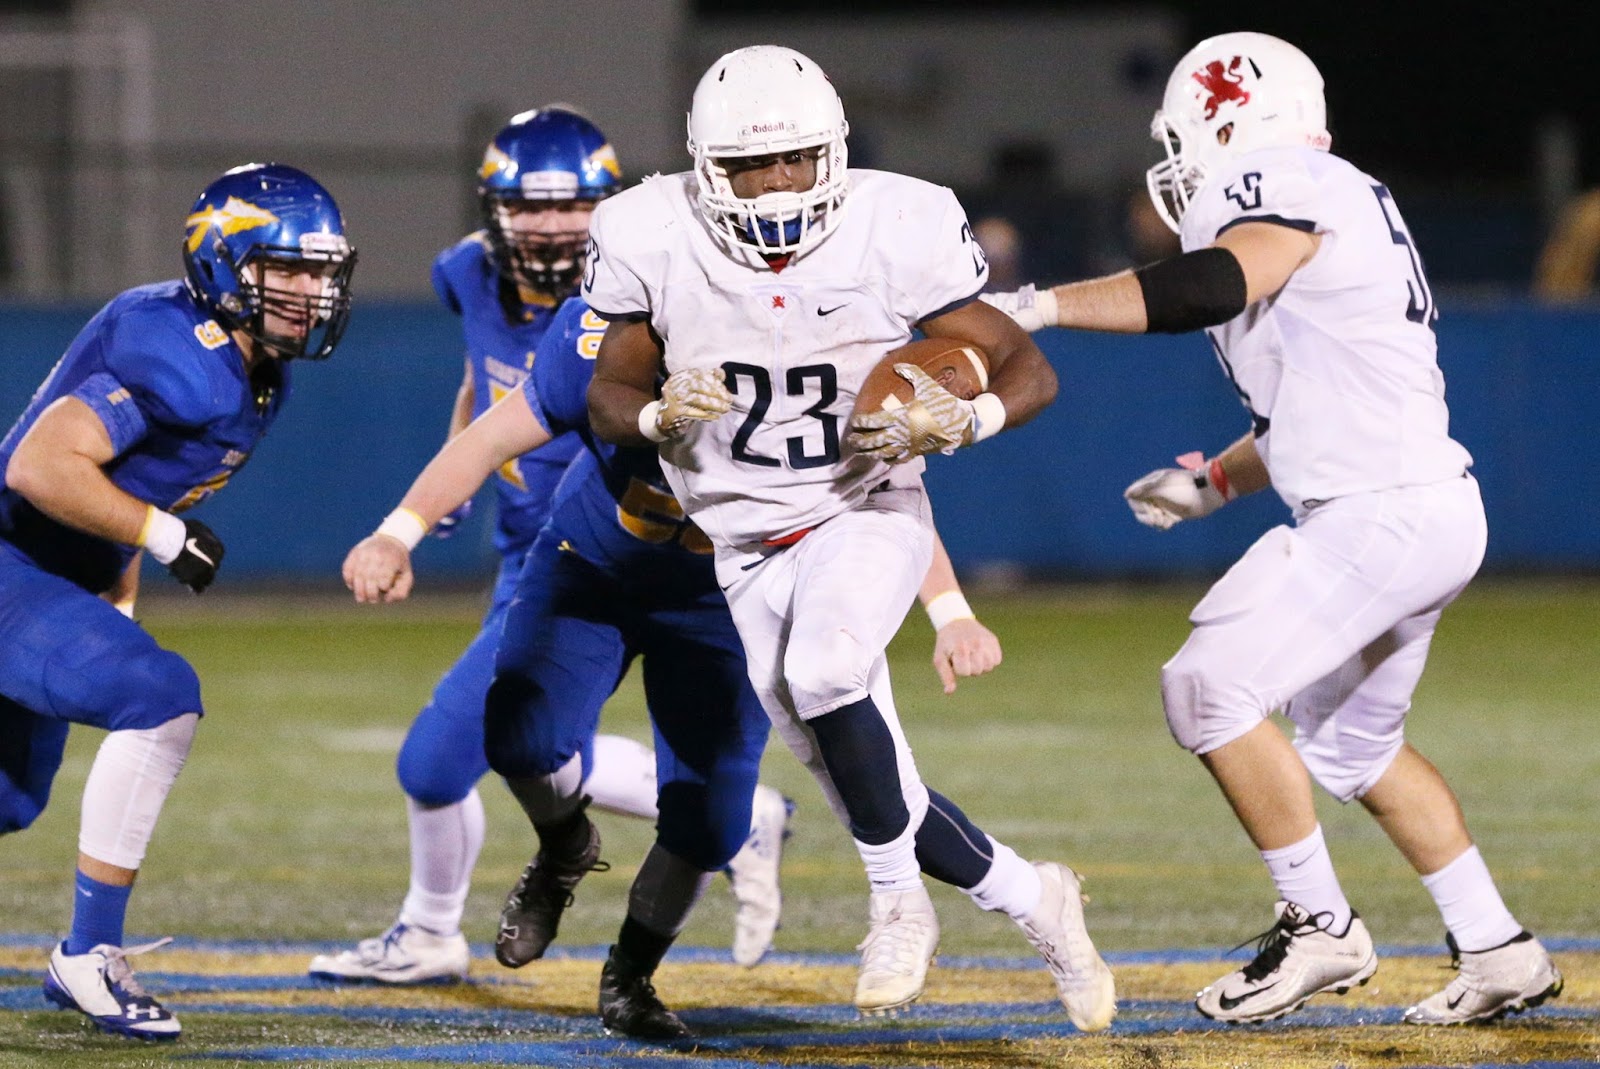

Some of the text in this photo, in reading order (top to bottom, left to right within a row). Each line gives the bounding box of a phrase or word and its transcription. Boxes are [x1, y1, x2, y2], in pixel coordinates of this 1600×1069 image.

[751, 121, 785, 134] Riddell
[960, 221, 988, 279] 2
[1369, 183, 1433, 326] 5
[193, 319, 230, 351] 9
[720, 360, 841, 471] 23
